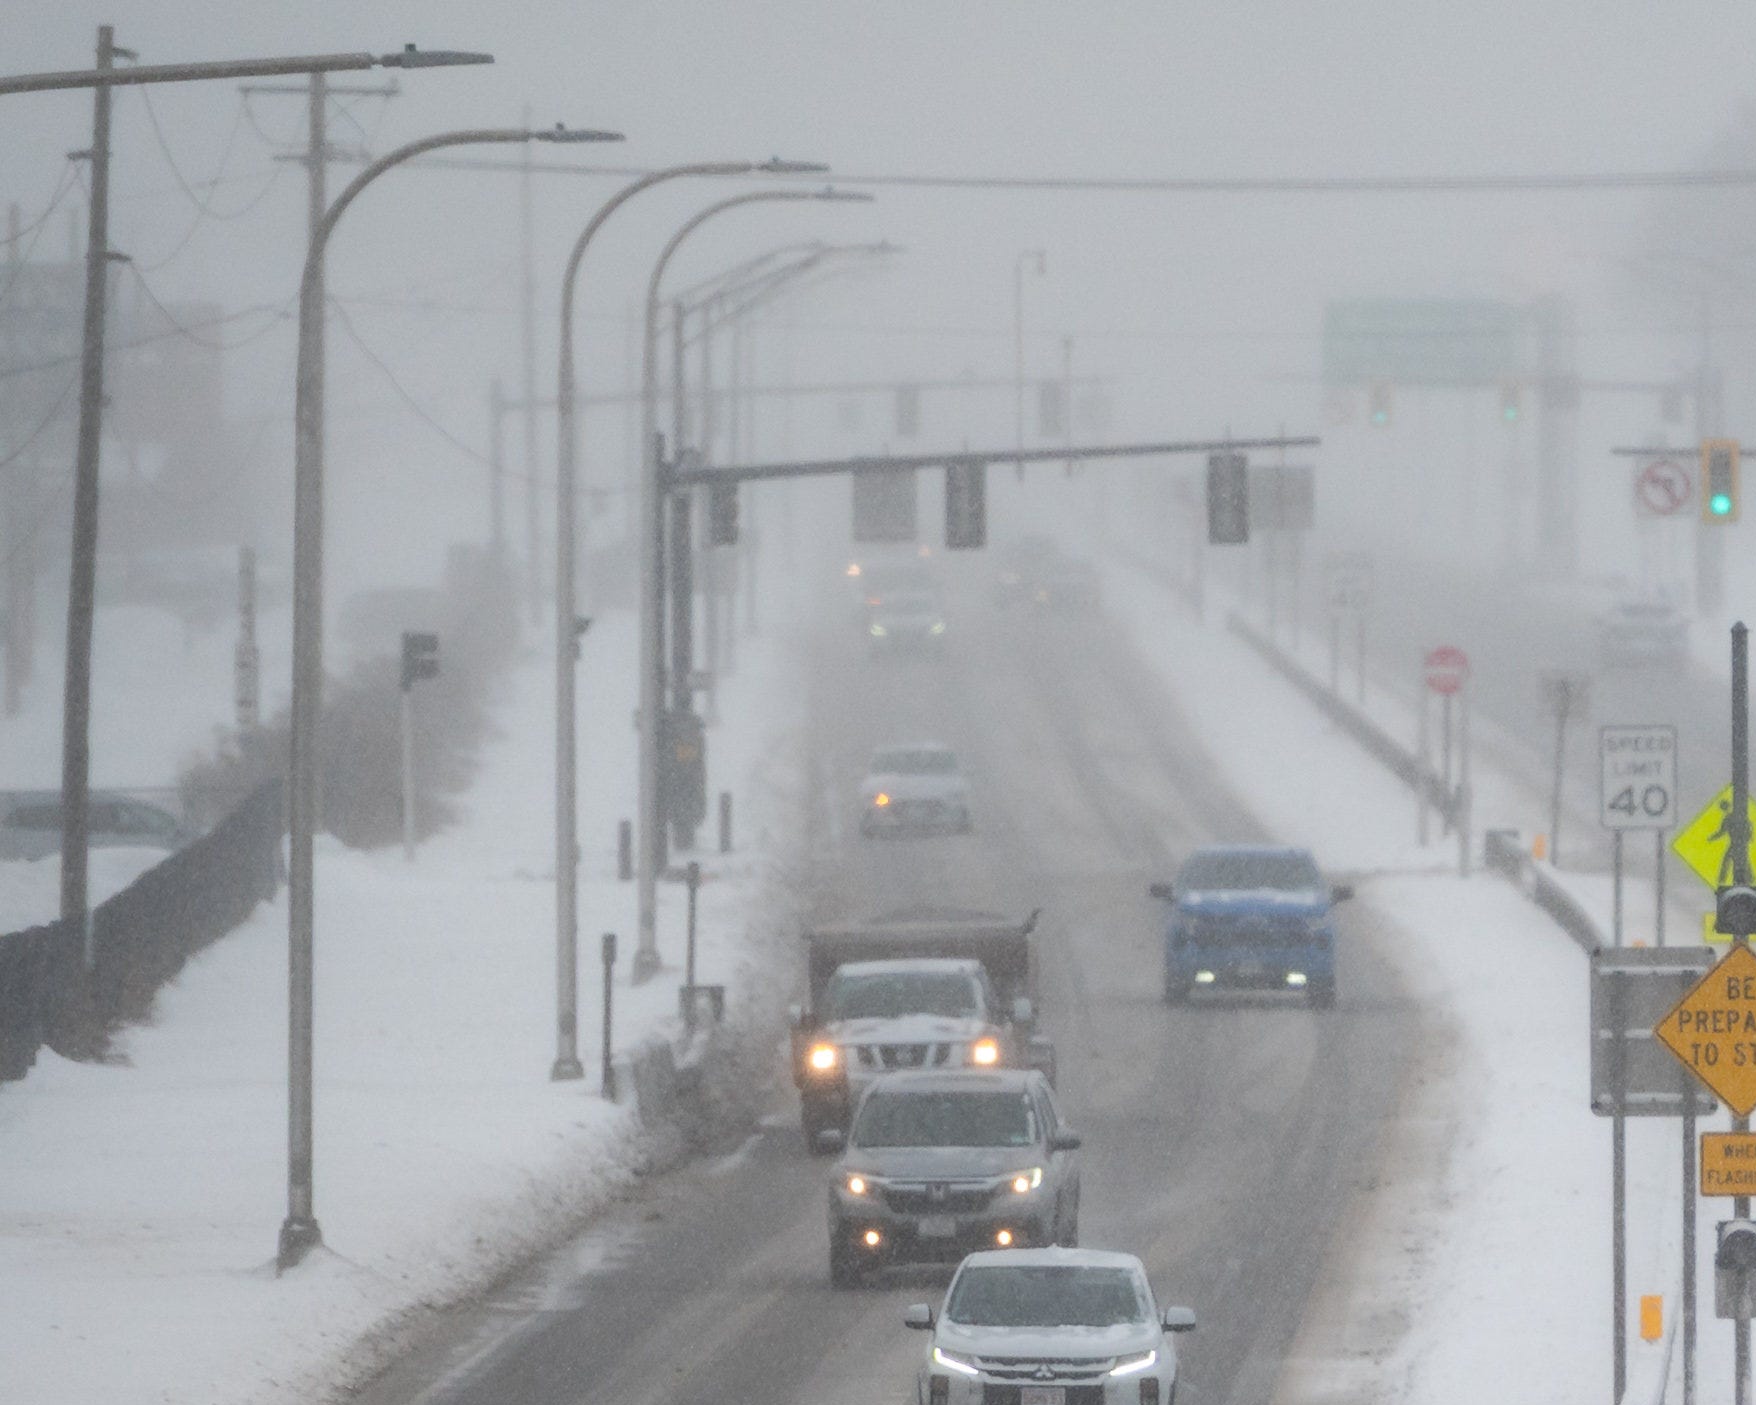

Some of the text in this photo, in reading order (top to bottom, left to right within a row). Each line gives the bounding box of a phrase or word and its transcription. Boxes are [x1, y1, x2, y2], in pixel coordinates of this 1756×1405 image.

[1606, 737, 1672, 753] SPEED
[1612, 760, 1663, 777] LIMIT
[1608, 784, 1669, 817] 40
[1726, 976, 1756, 1001] BE
[1690, 1042, 1721, 1067] TO
